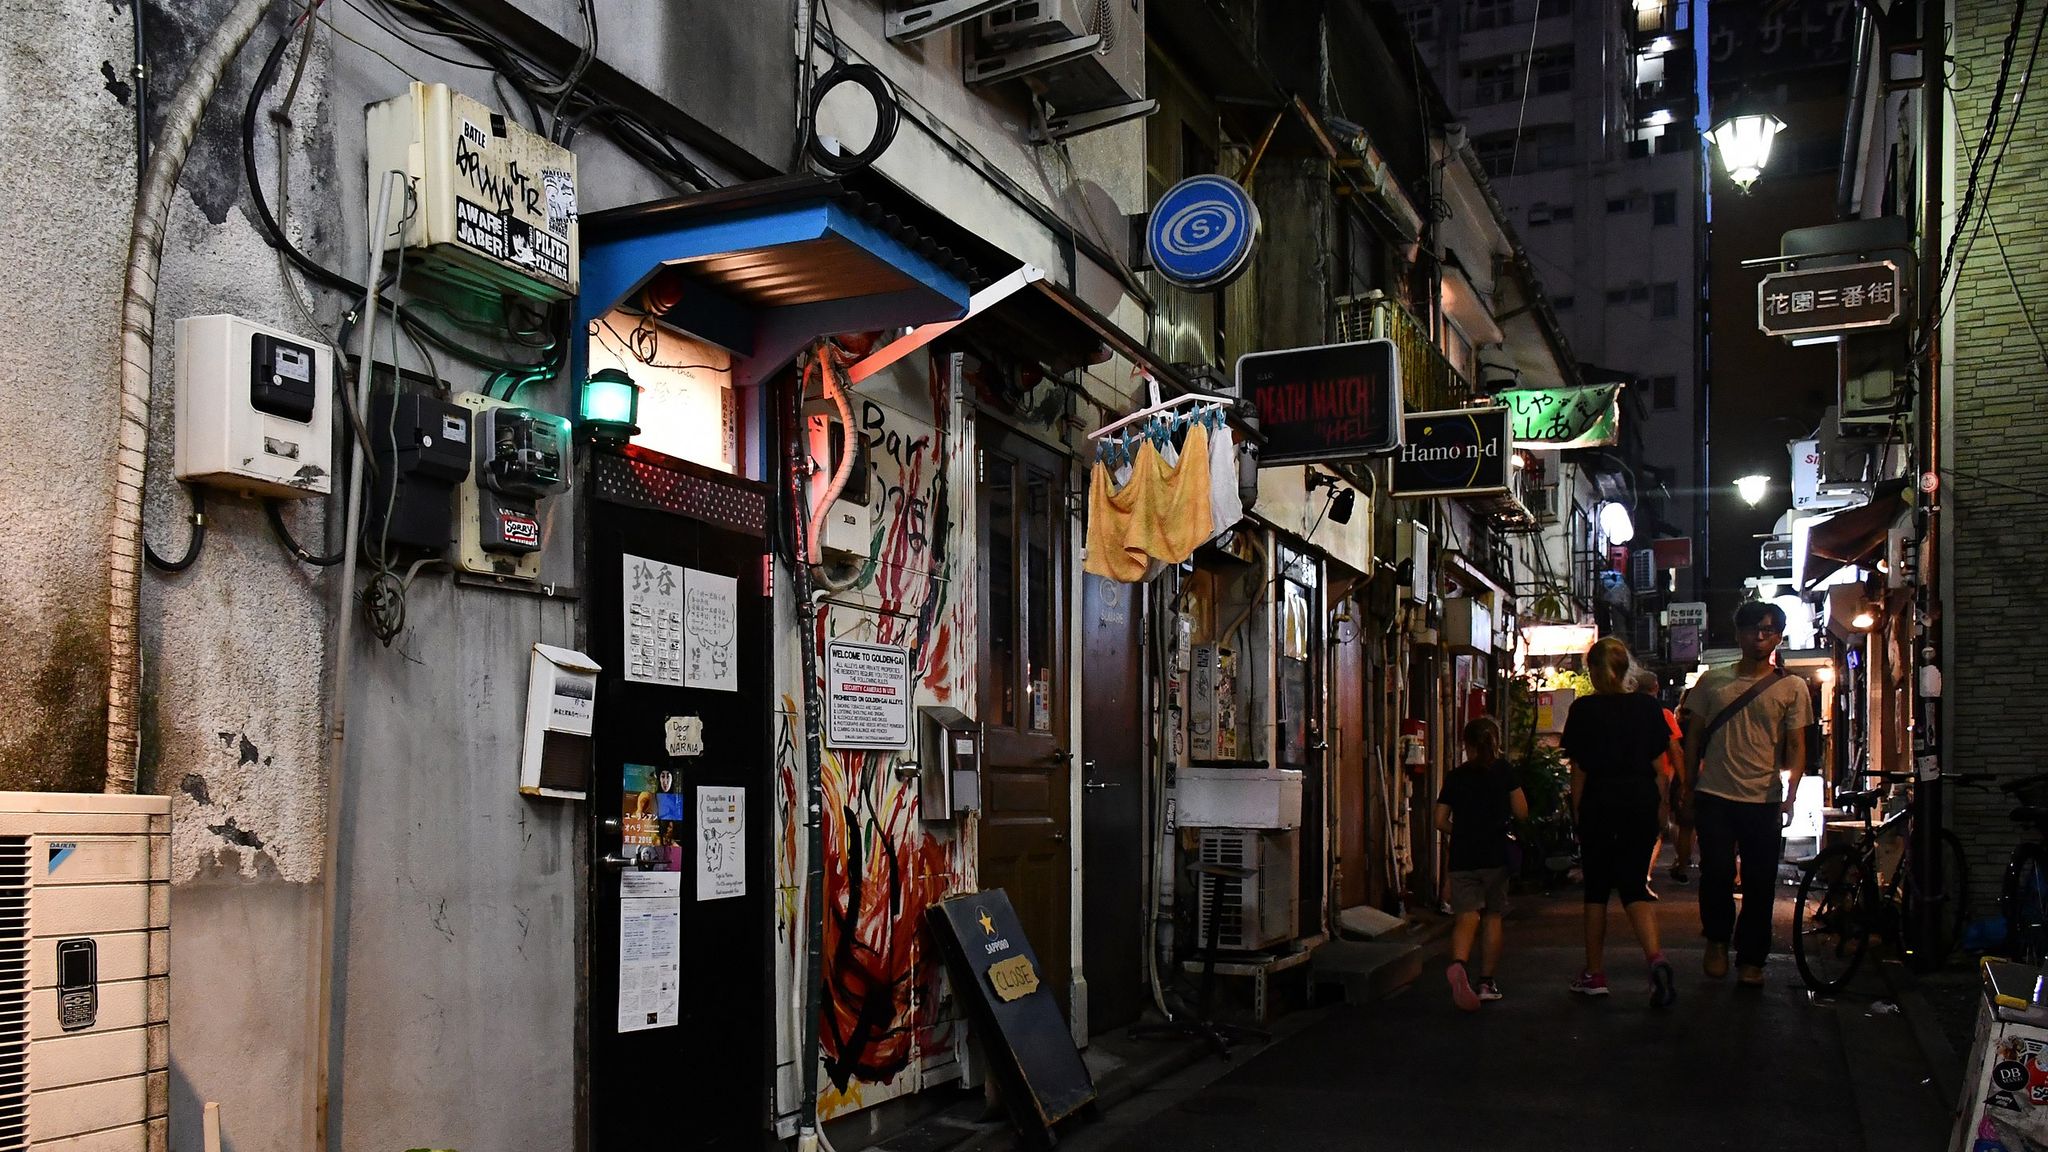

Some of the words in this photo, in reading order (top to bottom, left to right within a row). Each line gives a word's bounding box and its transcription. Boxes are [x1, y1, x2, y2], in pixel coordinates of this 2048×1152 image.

[464, 122, 486, 149] BATLE
[457, 202, 503, 236] AWARE
[457, 221, 504, 259] JABER
[535, 229, 569, 265] PILFER
[1766, 281, 1893, 317] 花園三番街
[1255, 380, 1307, 426] DEATH
[862, 400, 930, 467] Bar
[1513, 408, 1600, 440] しあと
[832, 649, 861, 661] WELCOME
[862, 653, 870, 662] TO
[833, 694, 857, 702] PROHIBITED
[843, 684, 863, 692] SECURITY
[672, 720, 690, 732] Door
[677, 733, 687, 742] to
[669, 742, 700, 754] NARNIA
[984, 938, 1010, 955] SAPPORO
[995, 965, 1034, 991] CLOSE
[2000, 1067, 2021, 1079] DB
